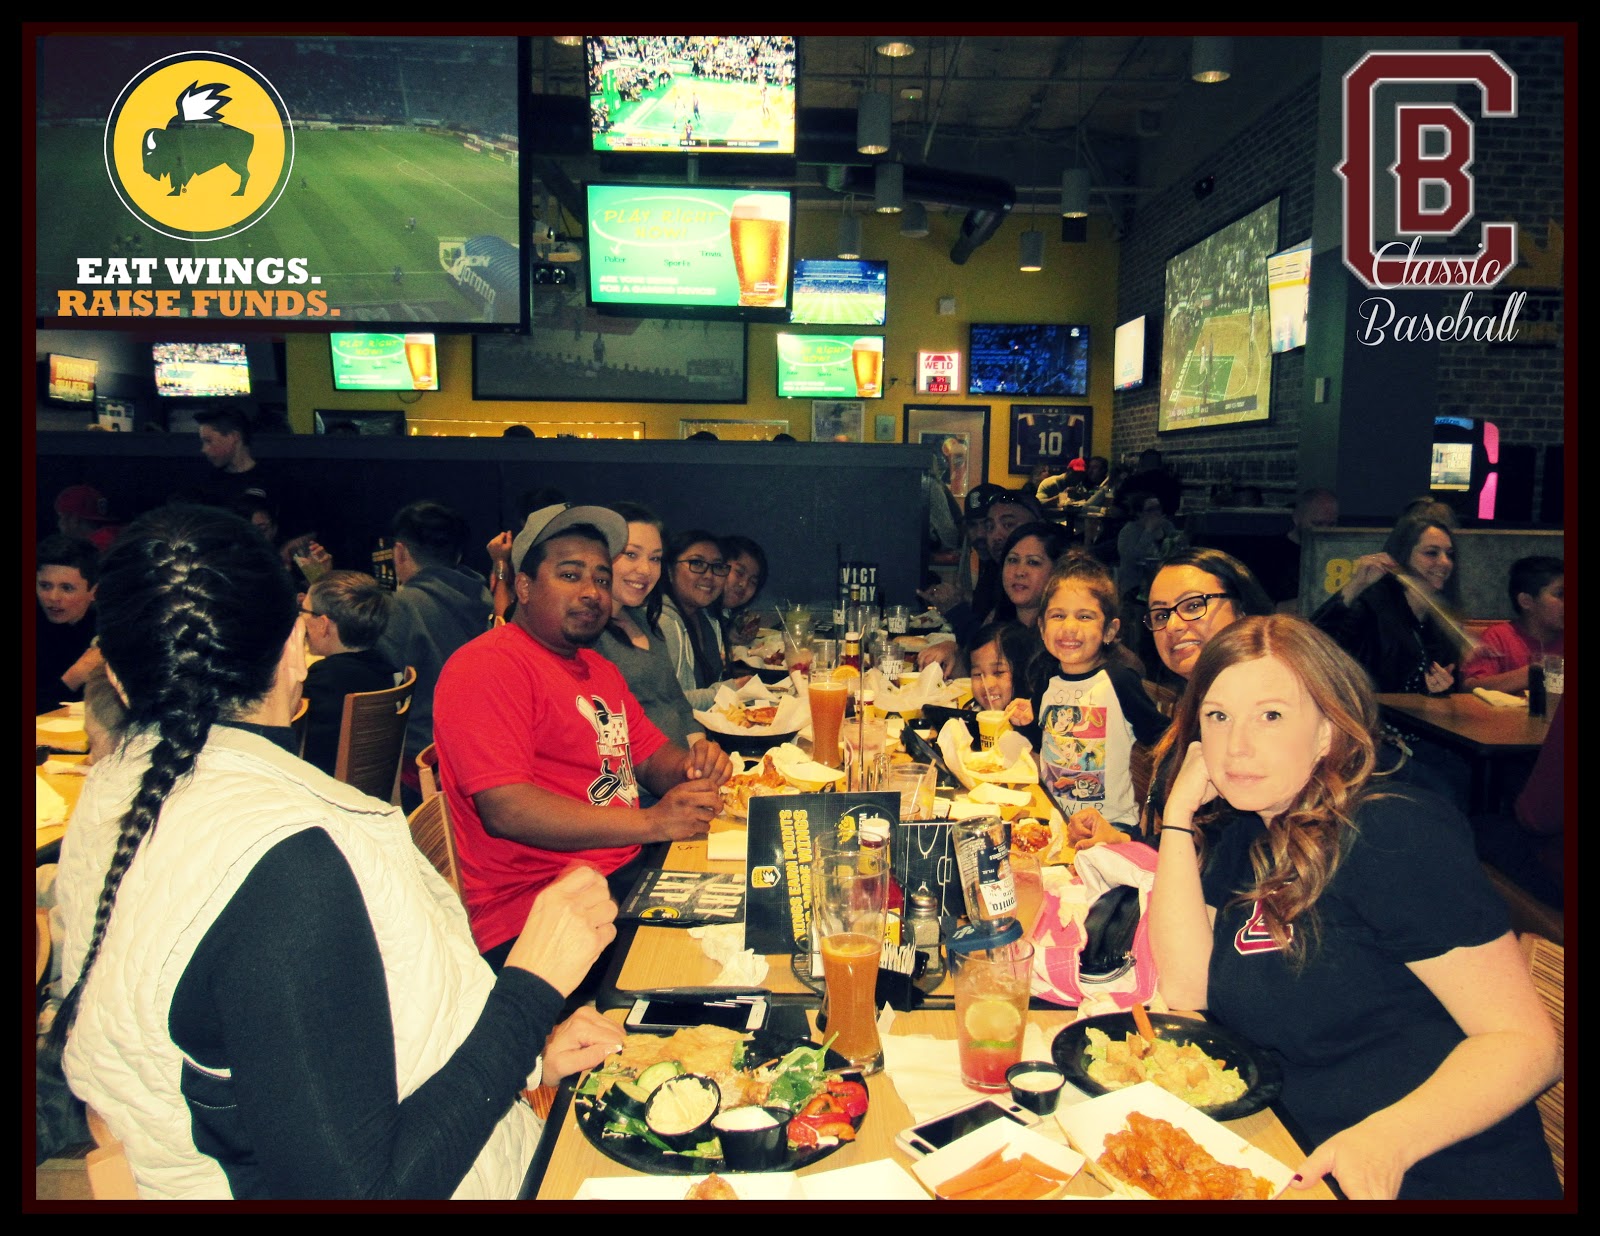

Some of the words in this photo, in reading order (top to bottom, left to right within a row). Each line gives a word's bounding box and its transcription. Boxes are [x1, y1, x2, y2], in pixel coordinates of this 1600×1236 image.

[604, 208, 651, 224] PLAY
[661, 208, 724, 224] RIGHT
[636, 226, 687, 240] NOW!
[925, 361, 938, 370] WE
[1039, 431, 1063, 456] 10
[842, 567, 876, 584] VICT
[1053, 689, 1097, 706] GIRL
[779, 810, 798, 860] POINTS
[793, 810, 813, 863] WINGS
[649, 872, 702, 902] LAP
[785, 860, 802, 896] EARN
